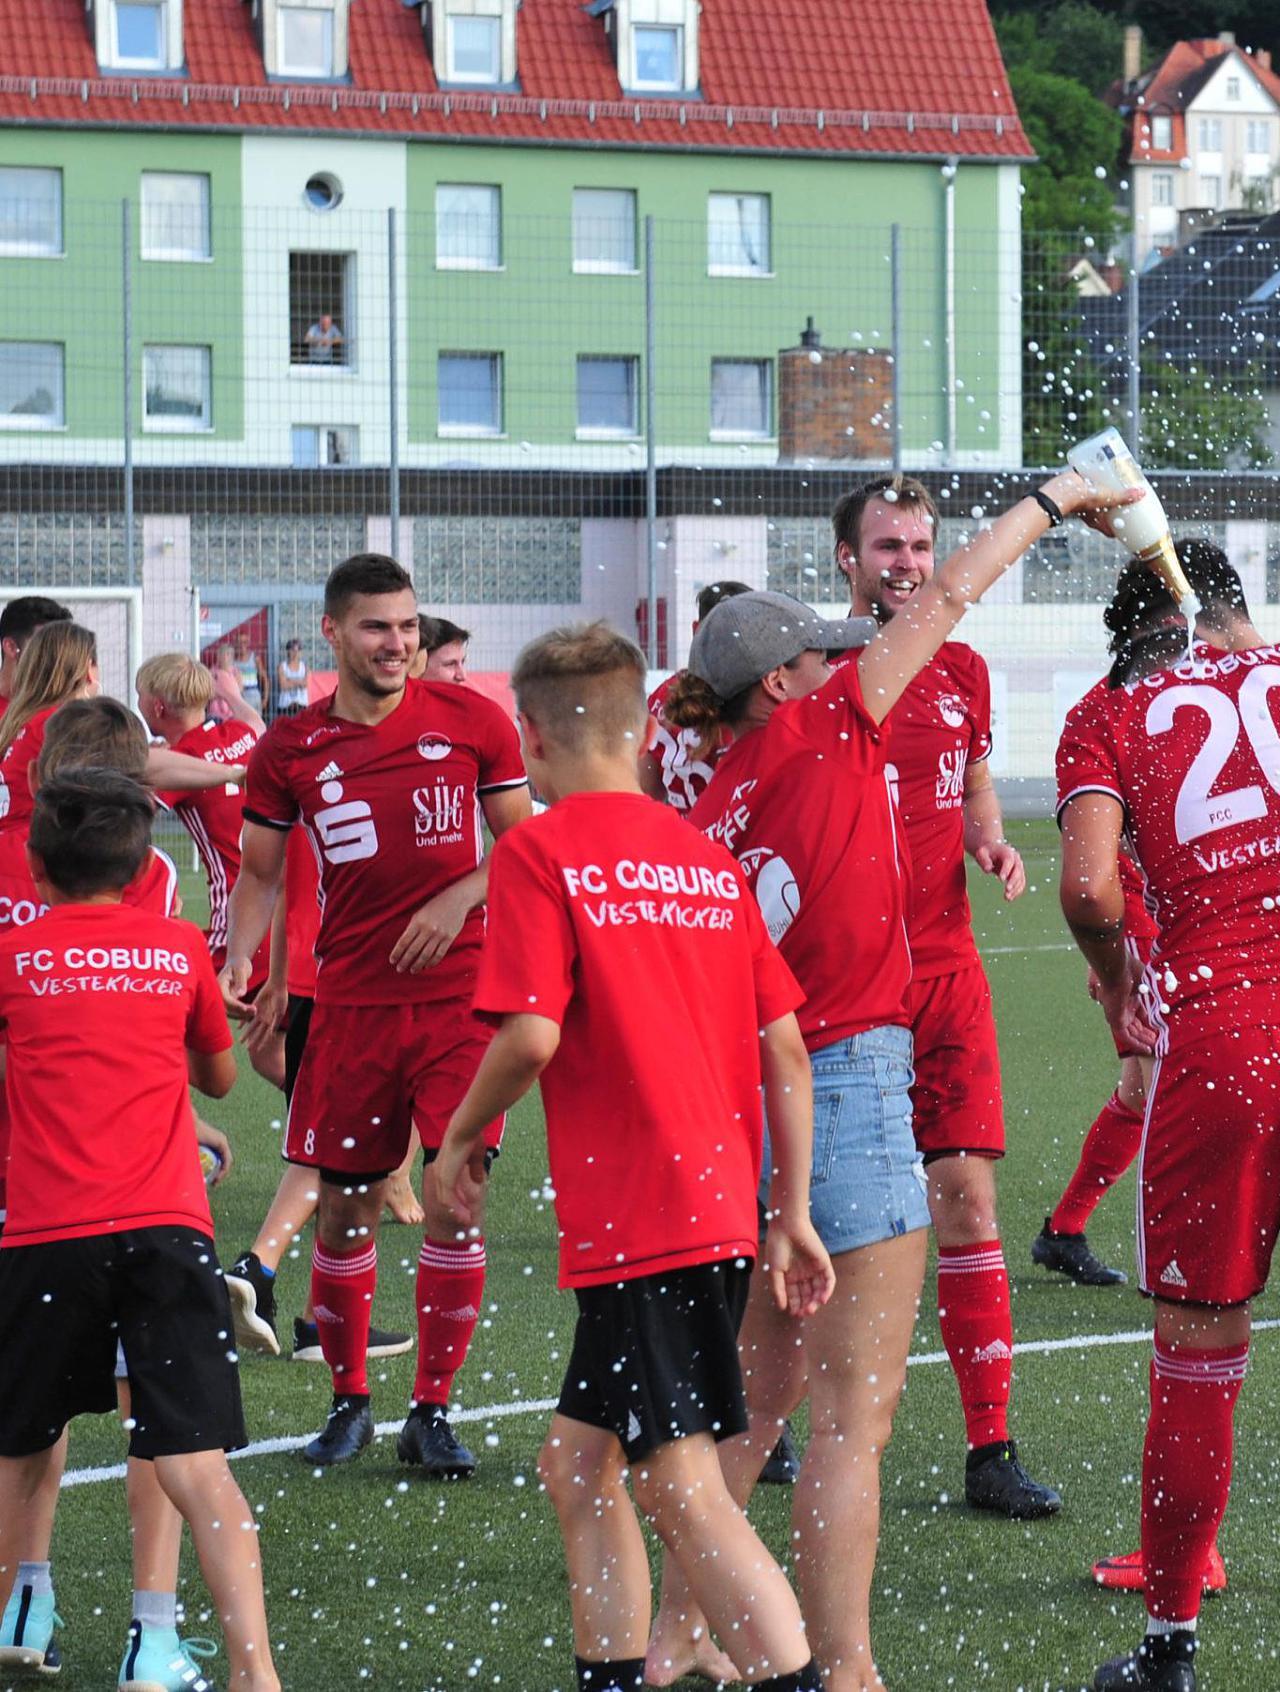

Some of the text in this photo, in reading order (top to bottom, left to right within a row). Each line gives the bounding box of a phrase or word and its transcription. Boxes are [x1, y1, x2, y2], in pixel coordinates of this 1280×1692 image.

[1209, 808, 1232, 825] FCC
[416, 835, 437, 848] Und
[562, 864, 608, 898] FC
[615, 859, 740, 900] COBURG
[583, 900, 734, 931] VESTEKICKER
[15, 948, 190, 976] FC COBURG
[29, 974, 183, 996] VESTEKICKER
[304, 1127, 315, 1156] 8
